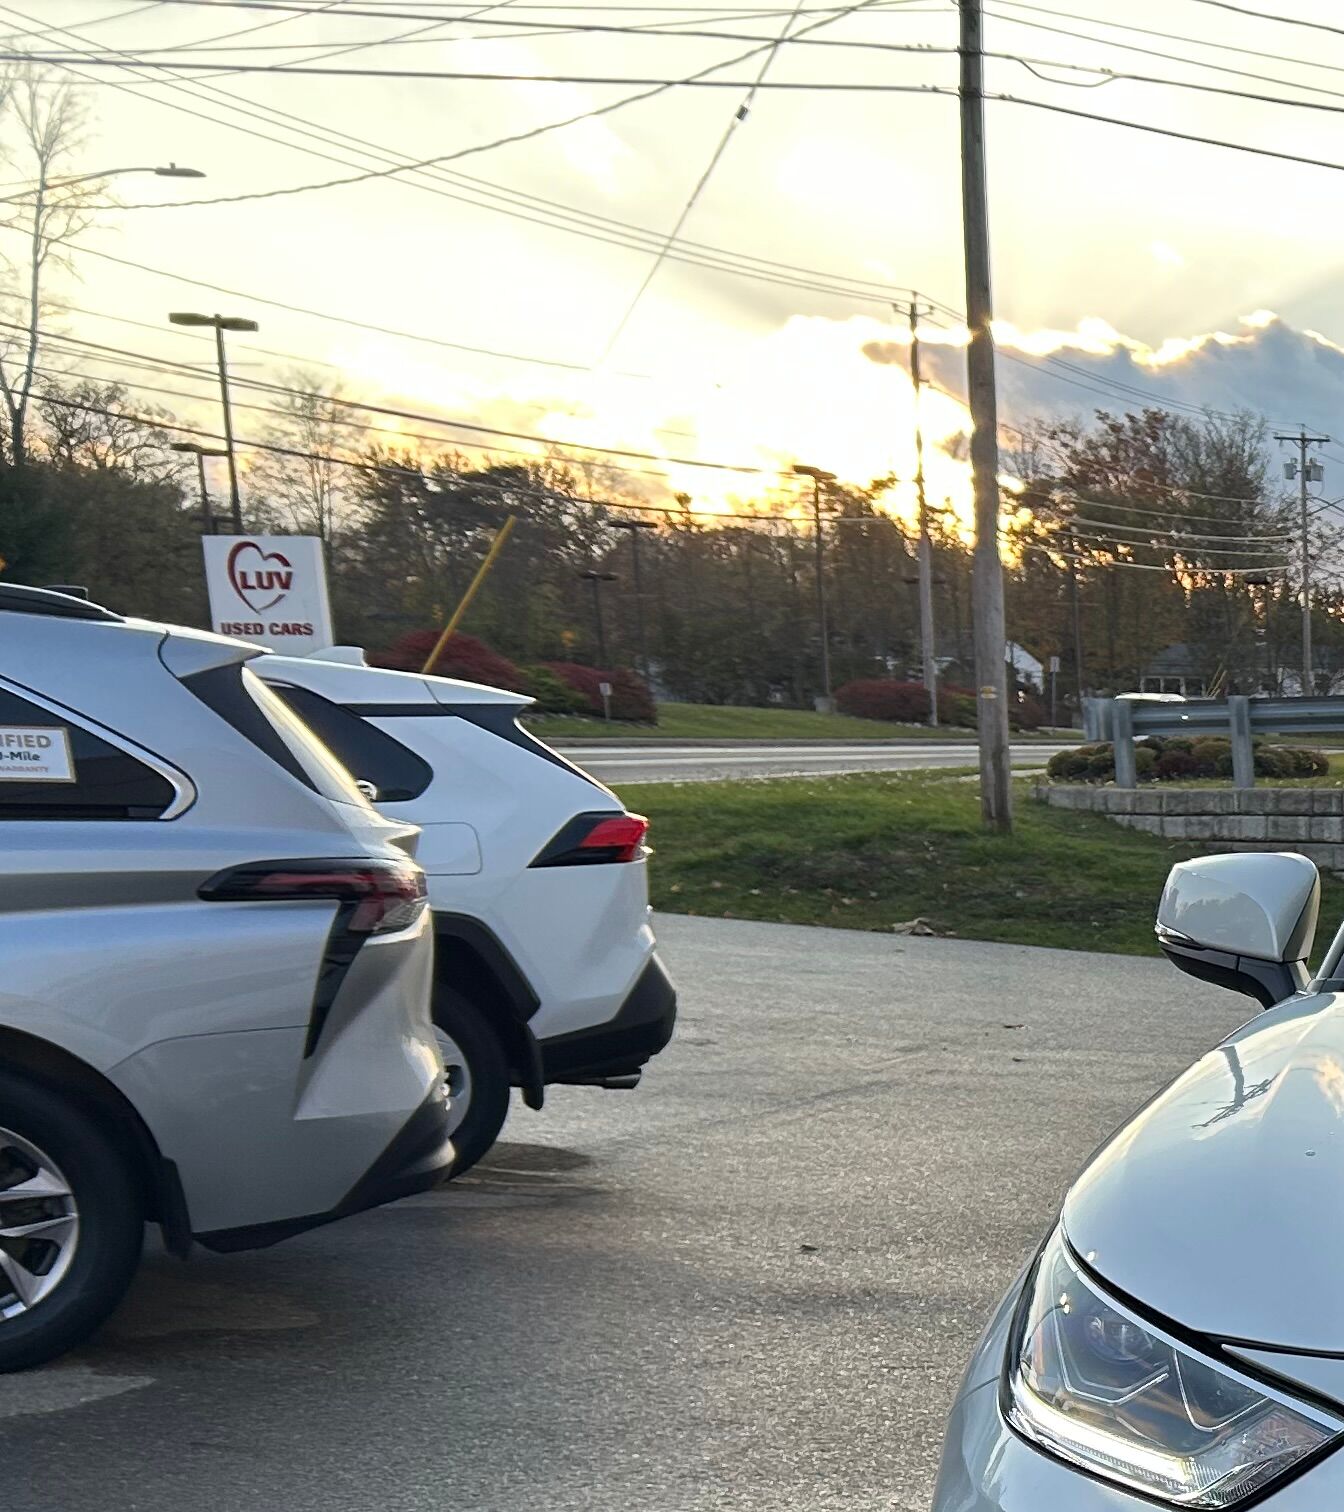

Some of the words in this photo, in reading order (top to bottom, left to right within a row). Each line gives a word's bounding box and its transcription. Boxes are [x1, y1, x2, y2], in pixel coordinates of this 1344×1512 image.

[239, 570, 293, 591] LUV
[221, 622, 264, 636] USED
[269, 622, 314, 636] CARS
